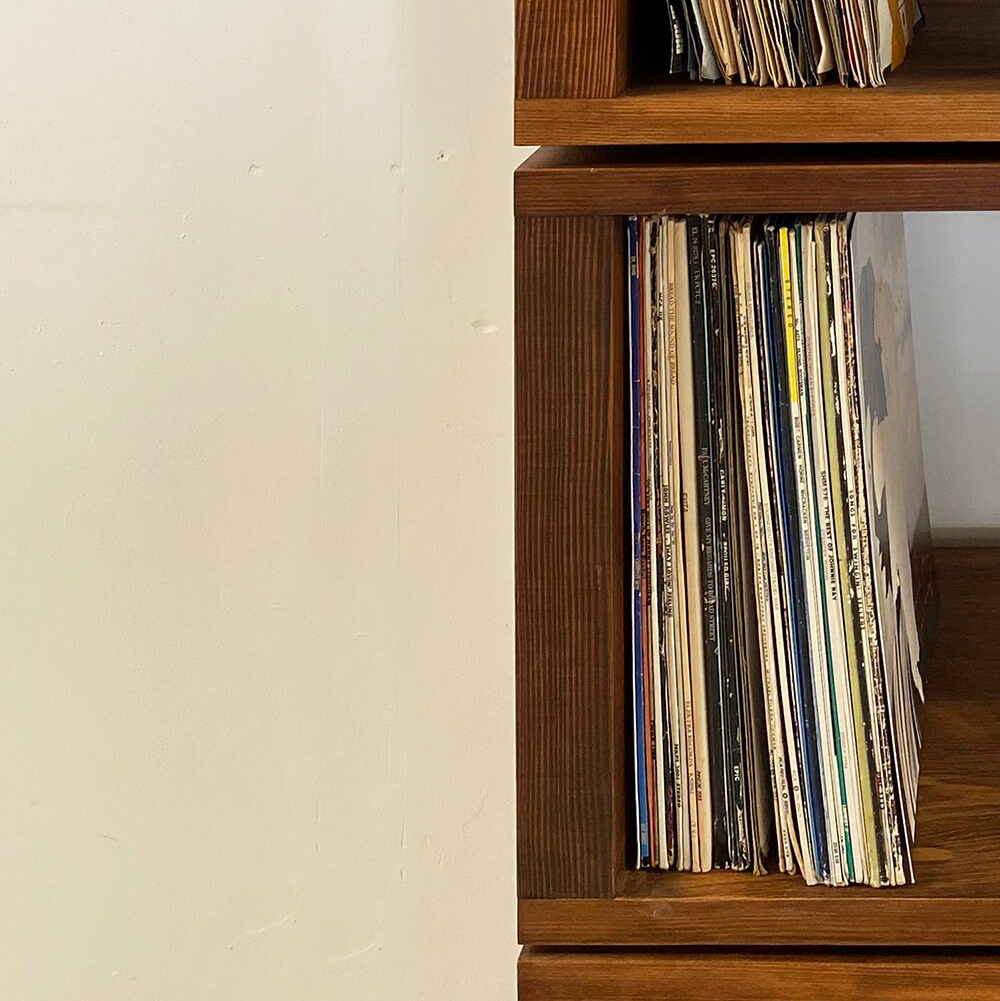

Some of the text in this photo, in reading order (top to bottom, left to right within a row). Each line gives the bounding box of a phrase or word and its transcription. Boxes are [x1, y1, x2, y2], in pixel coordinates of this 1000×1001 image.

[710, 264, 718, 287] 26376
[784, 279, 793, 328] STEREO
[663, 485, 671, 502] JOHN
[702, 464, 710, 506] McCARTNEY
[800, 489, 808, 524] McCRACKEN
[827, 542, 833, 551] OF
[828, 554, 836, 584] JOHNNIE
